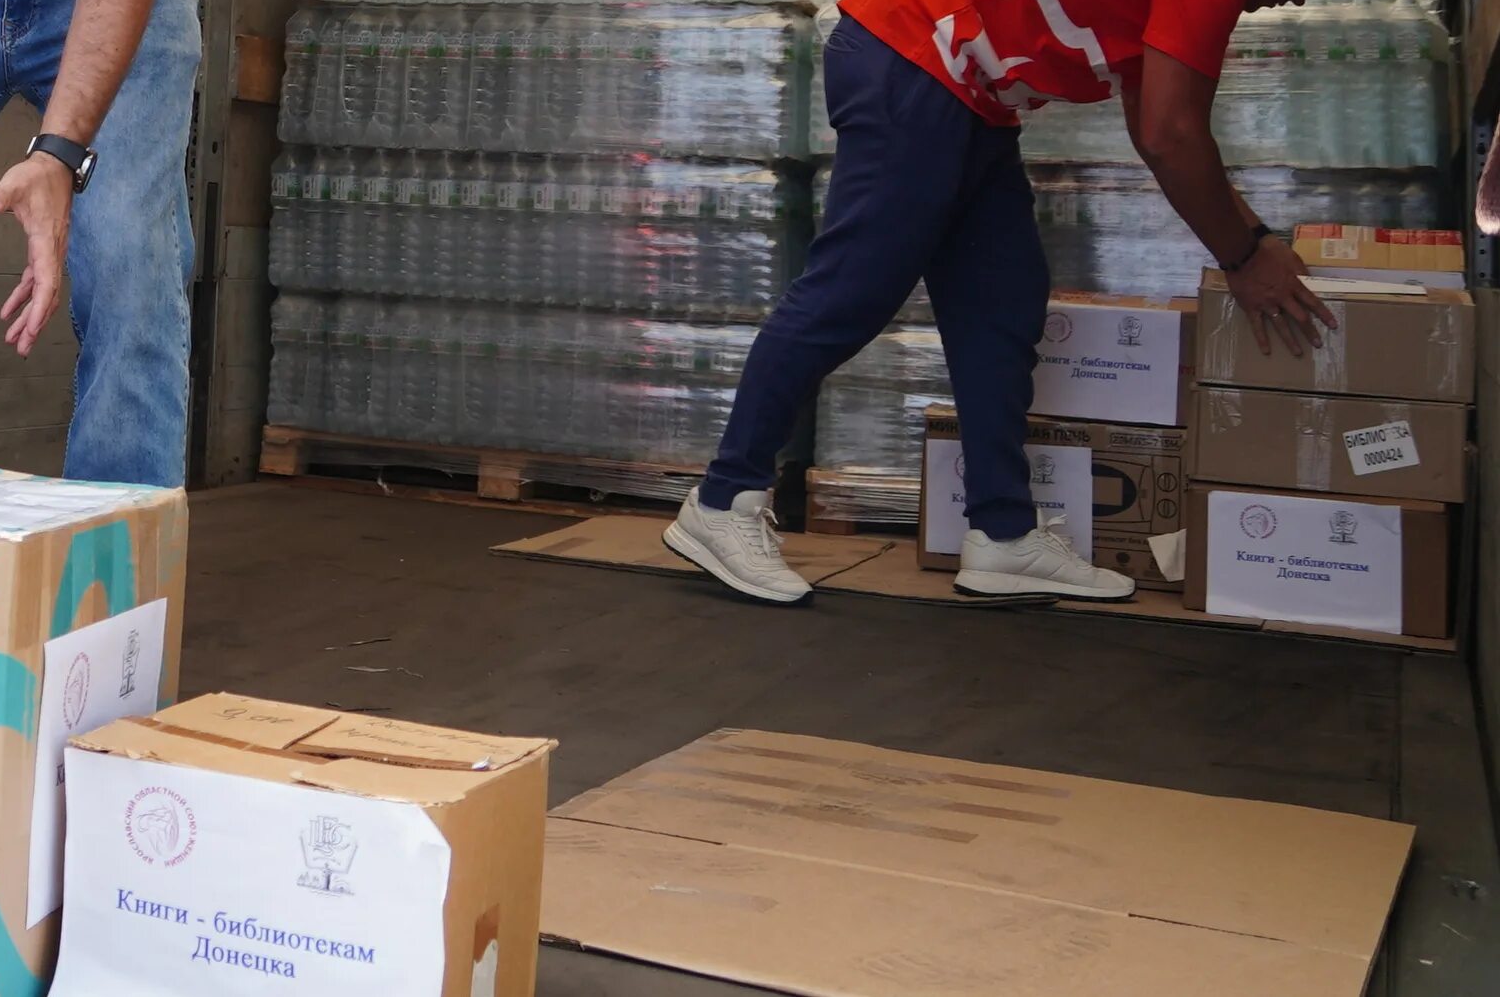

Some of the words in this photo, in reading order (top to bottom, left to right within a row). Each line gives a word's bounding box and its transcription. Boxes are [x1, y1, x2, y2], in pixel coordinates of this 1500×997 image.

[1037, 353, 1070, 366] Книги
[1080, 356, 1151, 371] библиотекам
[1071, 367, 1118, 381] Донецка
[1236, 550, 1275, 564] Книги
[1287, 554, 1369, 573] библиотекам
[1277, 567, 1331, 582] Донецка
[134, 786, 187, 806] ОБЛАСТНОЙ
[124, 799, 154, 865] ЯРОСЛАВСКИЙ
[185, 807, 197, 836] СОЮЗ
[116, 888, 188, 925] Книги
[212, 910, 376, 964] библиотекам
[192, 935, 296, 979] Донецка
